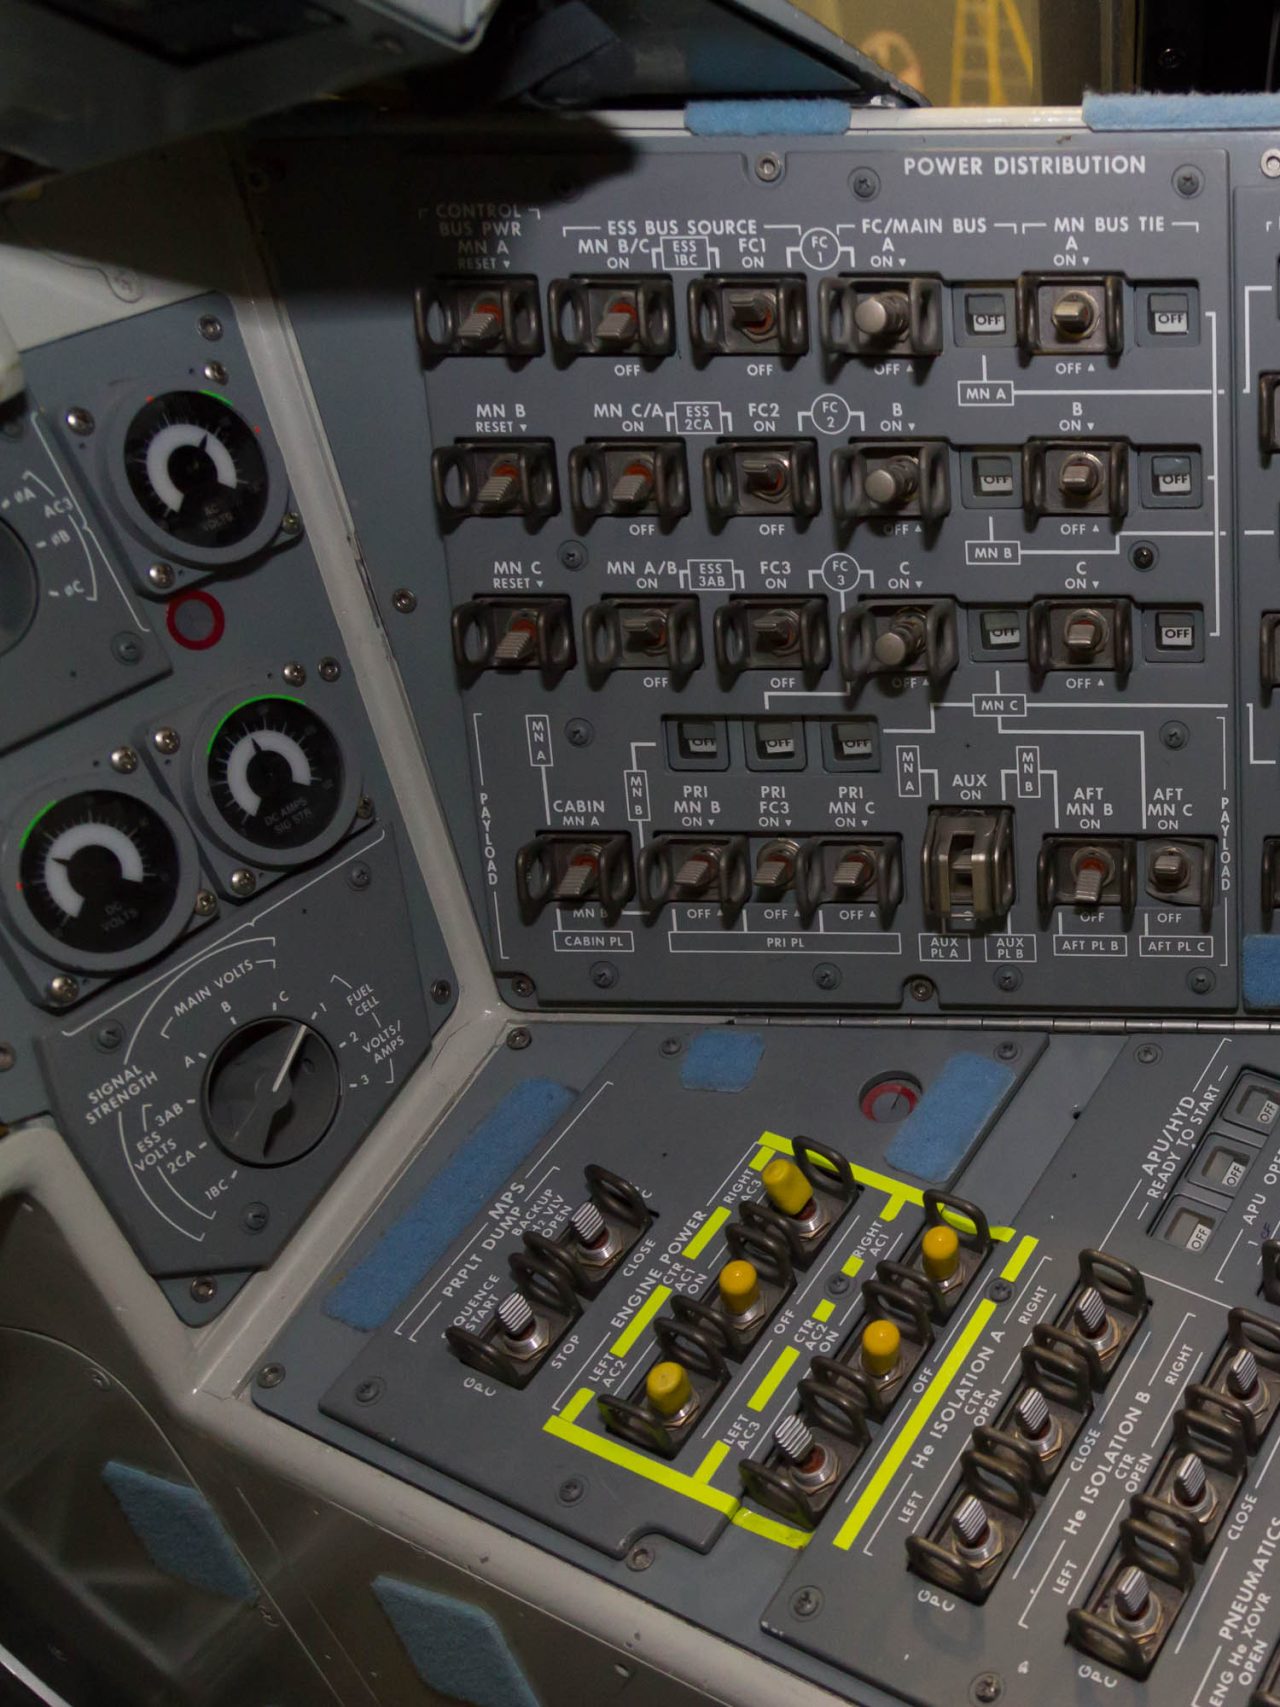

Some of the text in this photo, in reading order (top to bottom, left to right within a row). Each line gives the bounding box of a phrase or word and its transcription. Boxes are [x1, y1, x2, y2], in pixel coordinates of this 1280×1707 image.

[904, 156, 1146, 175] POWER DISTRIBUTION
[608, 221, 757, 235] ESS BUS SOURCE
[863, 218, 986, 234] FC/MAIN BUS
[1055, 217, 1164, 232] MN BUS TIE
[739, 239, 765, 253] FC1
[1158, 313, 1184, 324] OFF
[614, 365, 640, 376] OFF
[476, 421, 513, 432] RESET
[760, 561, 791, 574] FC3
[684, 786, 708, 798] PRI
[952, 775, 986, 786] AUX
[1074, 788, 1103, 800] AFT
[565, 936, 623, 947] CABIN PL
[767, 937, 805, 949] PRI PL
[931, 937, 958, 947] AUX
[173, 959, 255, 1019] MAIN VOLTS
[346, 983, 375, 1008] FUEL
[354, 996, 380, 1018] CELL
[373, 1035, 406, 1064] AMPS
[85, 1070, 159, 1126] STRENGTH
[88, 1064, 143, 1105] SIGNAL
[1141, 1096, 1195, 1175] APU/HYD
[1147, 1084, 1221, 1199] READY TO START
[723, 1169, 754, 1205] RIGHT
[488, 1181, 526, 1222] MPS
[511, 1188, 554, 1236] BACKUP
[1242, 1192, 1266, 1225] APU
[542, 1205, 573, 1238] OPEN
[442, 1205, 521, 1298] PRPLT DUMP
[622, 1238, 656, 1277] CLOSE
[610, 1209, 708, 1328] ENGINE POWER
[551, 1334, 581, 1369] STOP
[805, 1324, 828, 1352] AC2
[911, 1329, 1005, 1469] He ISOLATION A
[1063, 1390, 1151, 1536] He ISOLATION B
[1240, 1592, 1272, 1638] XOVR
